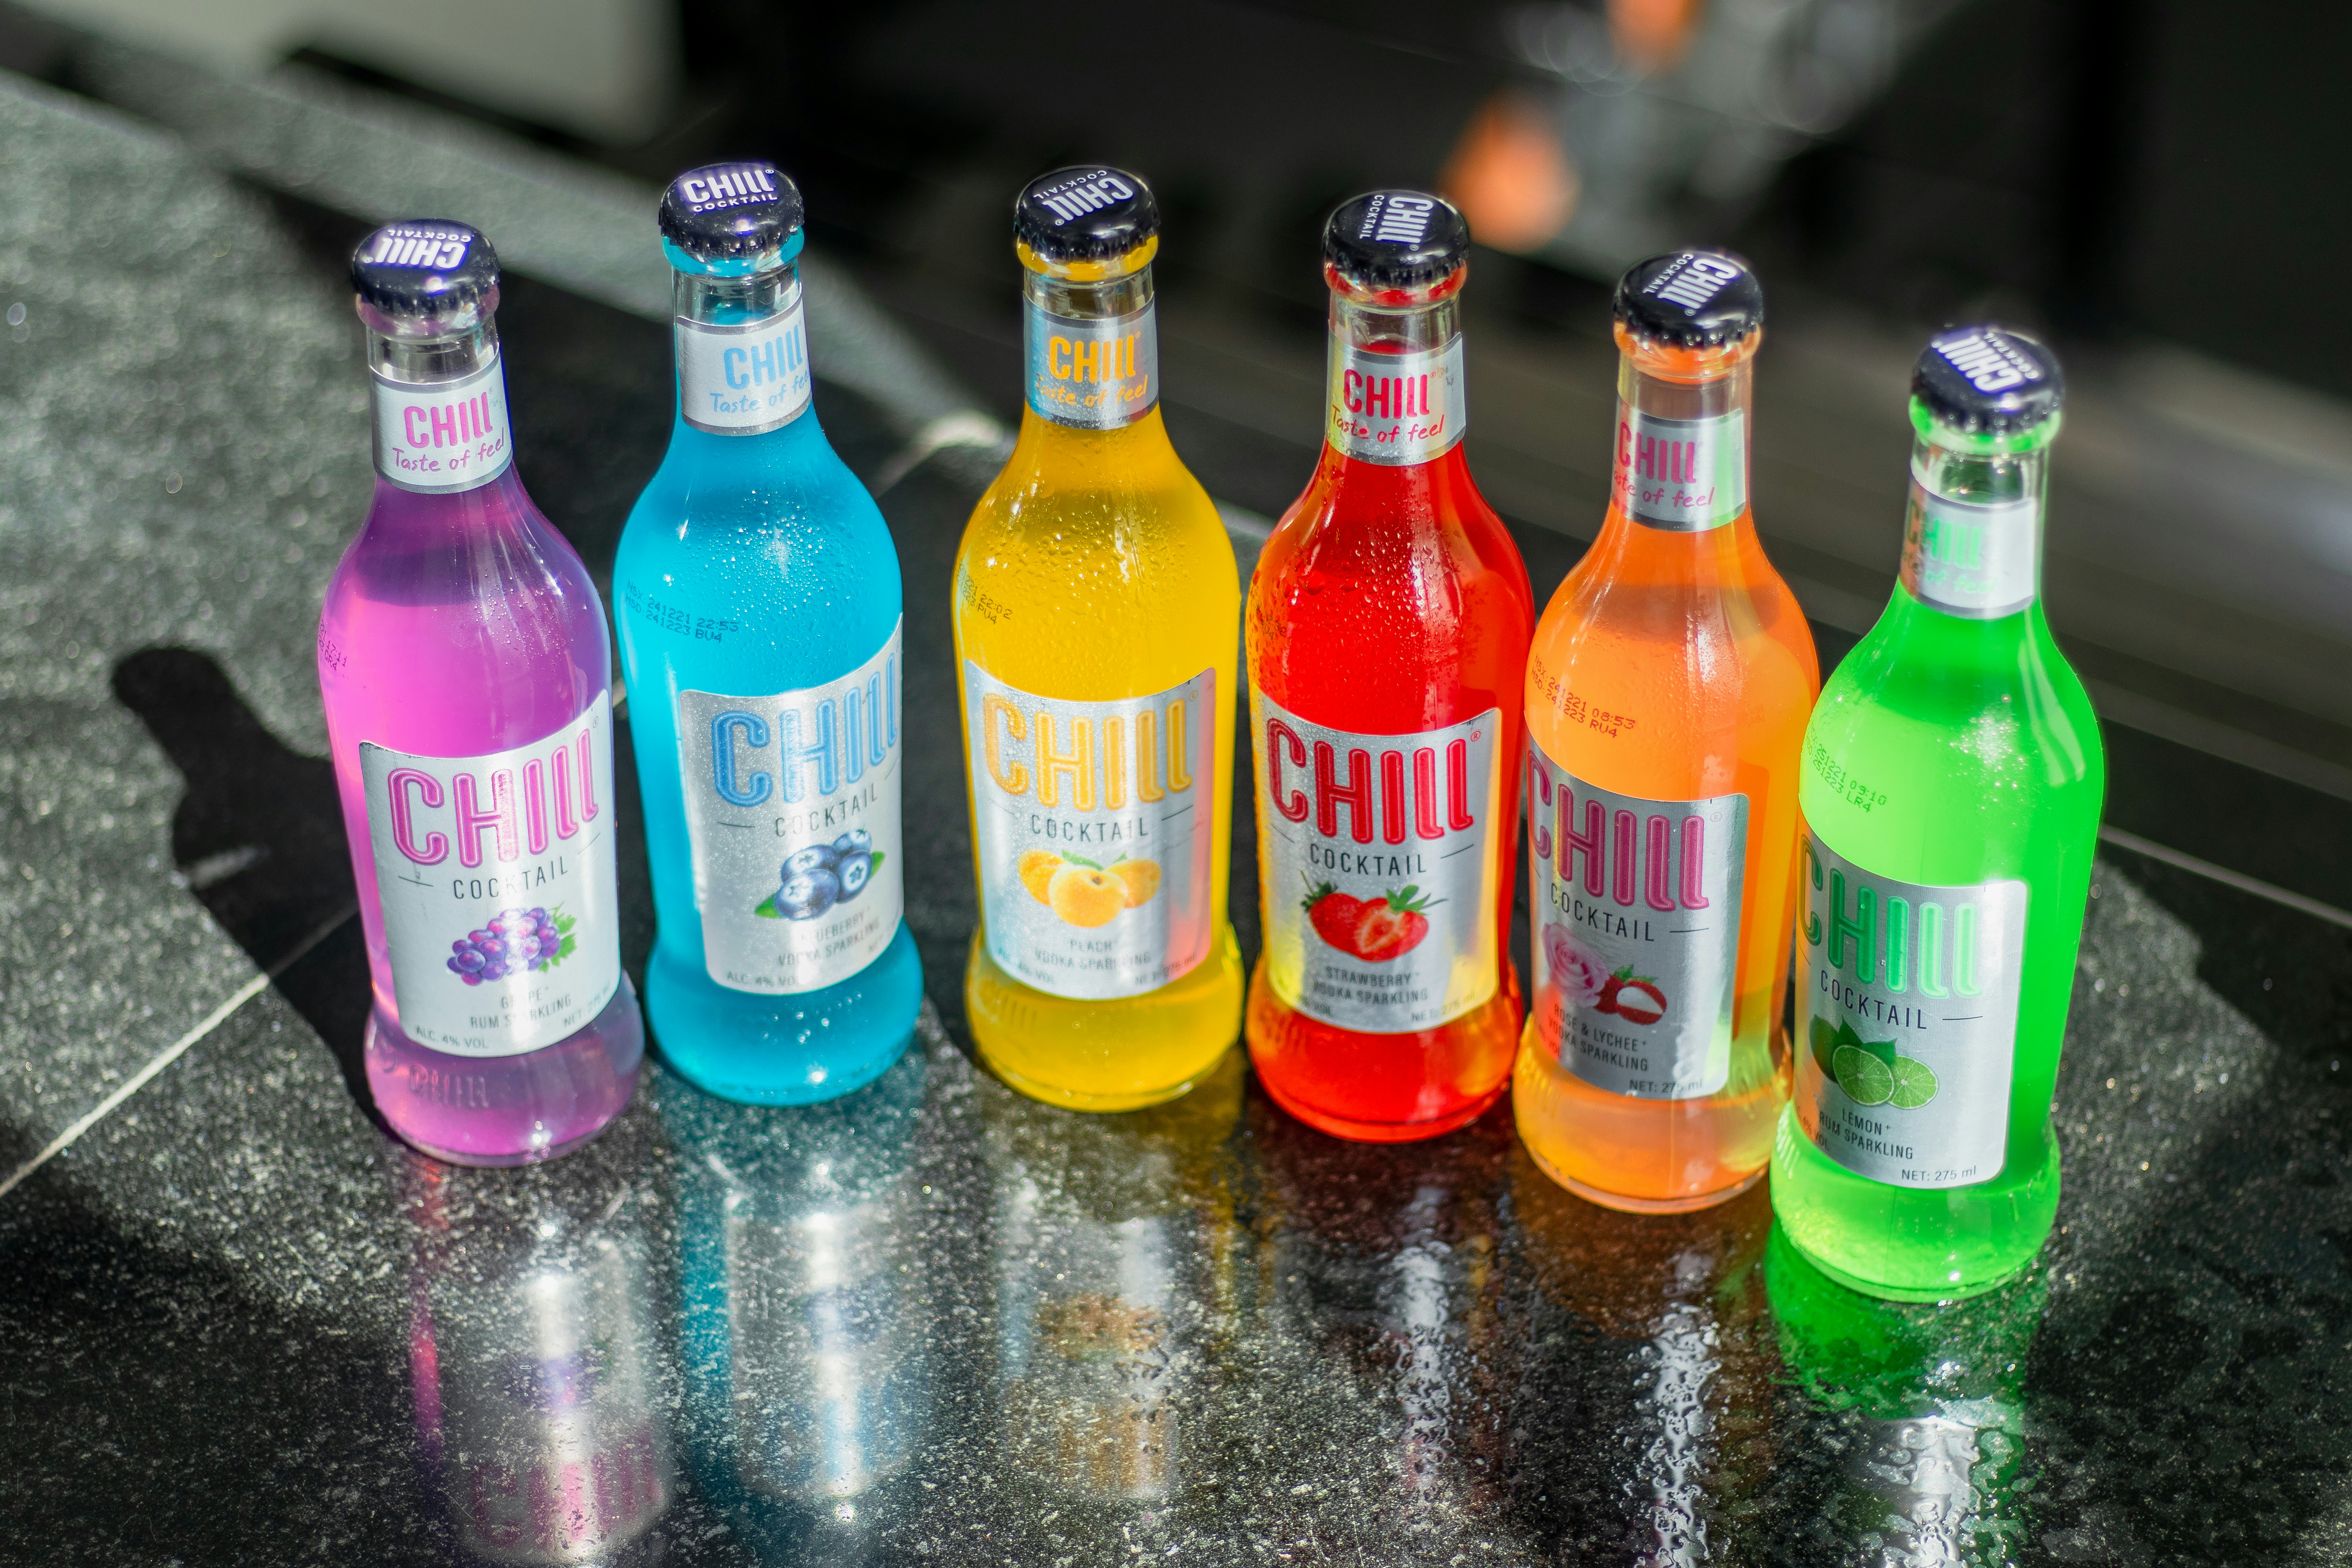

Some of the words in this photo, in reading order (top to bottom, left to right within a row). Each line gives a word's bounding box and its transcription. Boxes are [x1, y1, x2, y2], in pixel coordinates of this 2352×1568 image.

[1034, 170, 1107, 199] COCKTAIL
[693, 193, 778, 213] COCKTAIL
[1359, 195, 1384, 240] COCKTAIL
[388, 230, 472, 243] COCKTAIL
[1642, 253, 1694, 293] COCKTAIL
[710, 393, 759, 415] Taste
[769, 385, 786, 407] of
[793, 370, 809, 394] fee
[1035, 372, 1076, 405] Taste
[1086, 391, 1107, 407] of
[1116, 375, 1148, 402] feel
[1331, 404, 1368, 440] Taste
[1377, 425, 1399, 443] of
[1408, 414, 1444, 442] feel
[393, 448, 441, 472] Taste
[450, 450, 470, 470] of
[478, 427, 504, 463] feel
[1643, 488, 1664, 505] of
[1672, 487, 1714, 508] feel
[1590, 719, 1617, 738] RU4
[1592, 708, 1635, 729] 08:53
[776, 784, 877, 837] COCKTAIL
[1846, 790, 1871, 813] LR4
[1031, 814, 1148, 842] COCKTAIL
[1310, 844, 1426, 876] COCKTAIL
[453, 856, 568, 899] COCKTAIL
[1551, 883, 1654, 941] COCKTAIL
[1035, 948, 1074, 968] VODKA
[1070, 939, 1112, 953] PEACH
[1326, 967, 1411, 987] STRAWBERRY
[1358, 988, 1428, 1005] SPARKLING
[1820, 969, 1927, 1029] COCKTAIL
[471, 1017, 500, 1029] RUM
[1555, 1004, 1577, 1029] ROSE
[1594, 1027, 1638, 1052] LYCHEE
[465, 1038, 488, 1048] VOL
[1548, 1016, 1576, 1047] VODKA
[1581, 1040, 1648, 1071] SPARKLING
[1630, 1079, 1657, 1092] NET:
[1662, 1082, 1684, 1093] 275
[1688, 1079, 1703, 1091] ml
[1819, 1111, 1840, 1135] RUM
[1845, 1128, 1913, 1160] SPARKLING
[1842, 1108, 1882, 1135] LEMON
[1902, 1169, 1930, 1181] NET:
[1935, 1170, 1957, 1181] 275
[1962, 1165, 1976, 1178] ml
